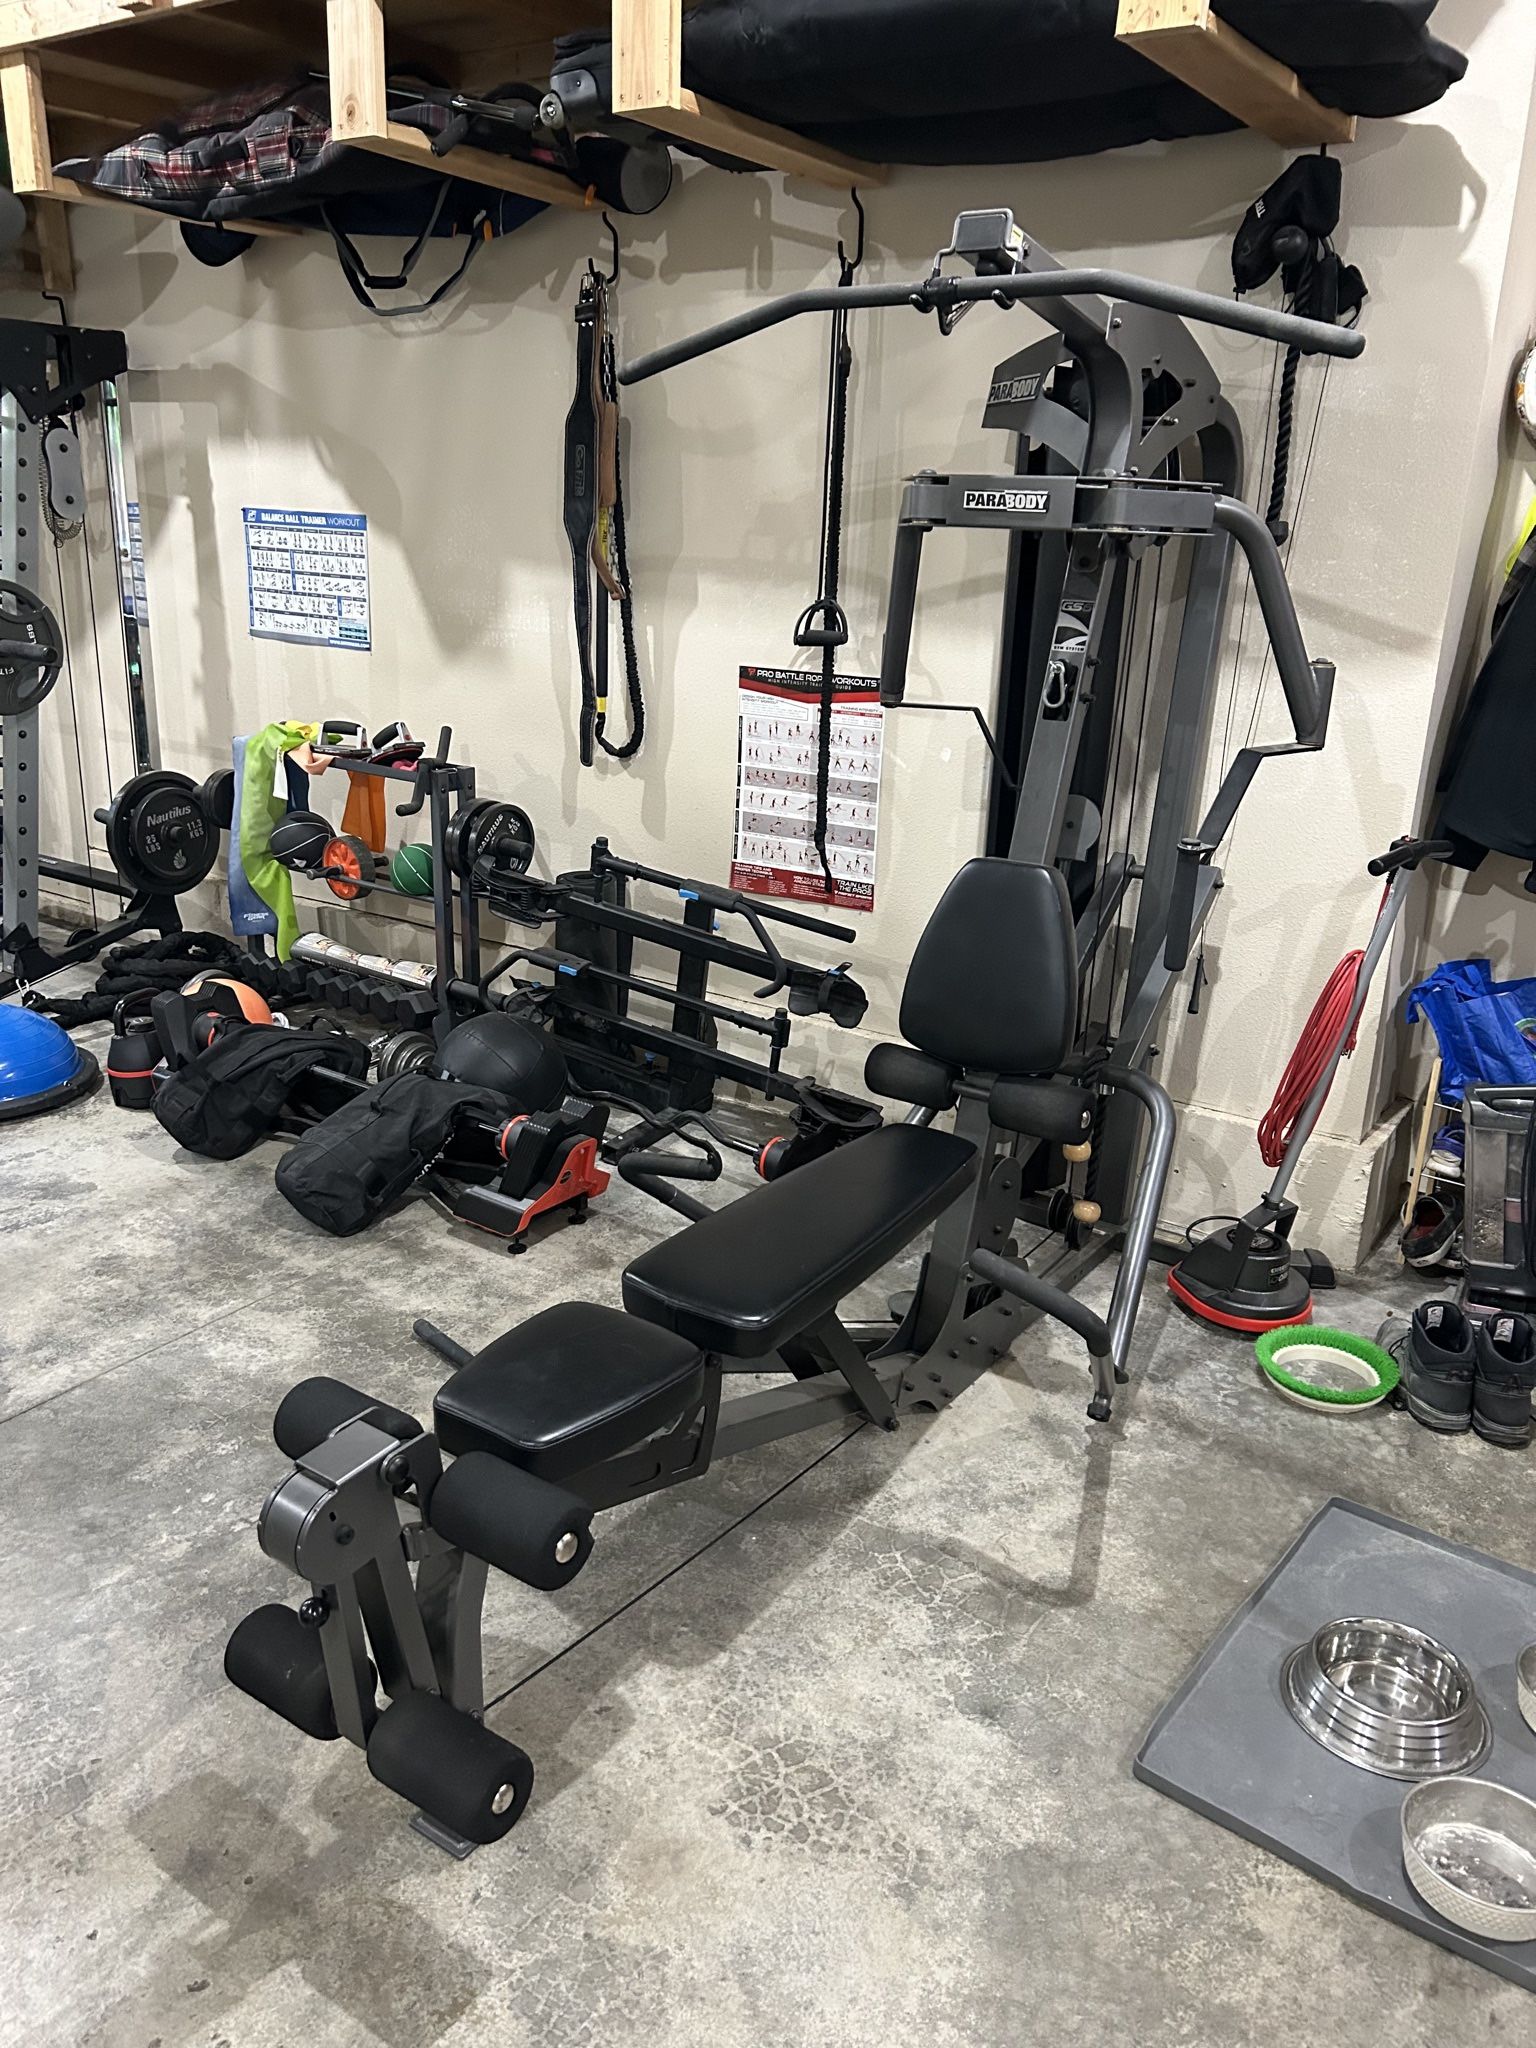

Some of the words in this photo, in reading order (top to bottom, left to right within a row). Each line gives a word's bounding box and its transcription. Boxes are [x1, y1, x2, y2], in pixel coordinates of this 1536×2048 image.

[1255, 198, 1266, 218] TRX
[988, 377, 1039, 402] PARABODY
[966, 493, 1047, 509] PARABODY
[261, 512, 285, 522] BALANCE
[285, 514, 300, 523] BALL
[300, 515, 327, 525] TRAINER
[327, 517, 360, 527] WORKOUT
[756, 669, 774, 678] PRO
[775, 671, 805, 681] BATTLE
[805, 674, 823, 682] ROP
[147, 806, 191, 827] Nautilus
[187, 819, 202, 830] 11.3
[146, 834, 157, 844] 25
[190, 828, 204, 839] KGS
[477, 813, 503, 854] NAUTILUS
[146, 842, 161, 854] LBS
[837, 880, 857, 888] TRAIN
[852, 887, 873, 896] PROS
